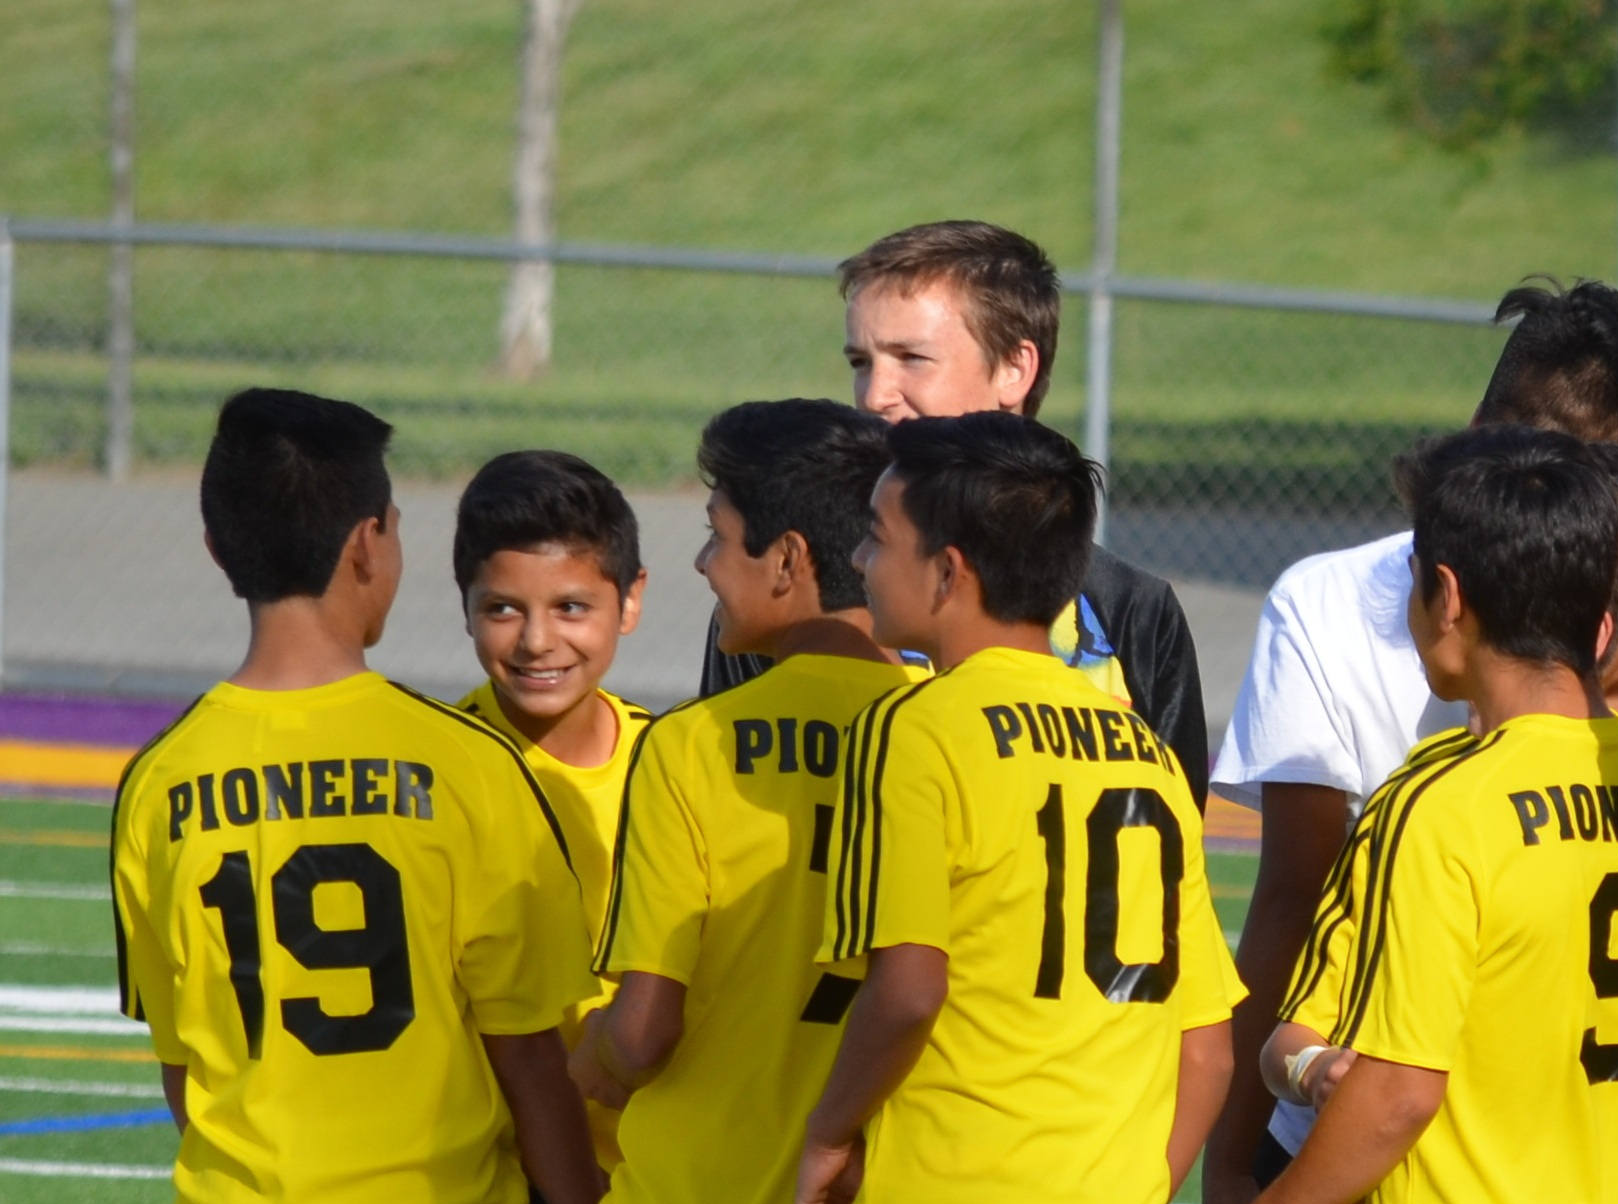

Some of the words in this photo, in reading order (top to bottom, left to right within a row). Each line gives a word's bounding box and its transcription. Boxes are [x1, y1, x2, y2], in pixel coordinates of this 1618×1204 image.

[168, 758, 434, 843] PIONEER
[1033, 783, 1185, 1004] 10
[198, 842, 416, 1060] 19
